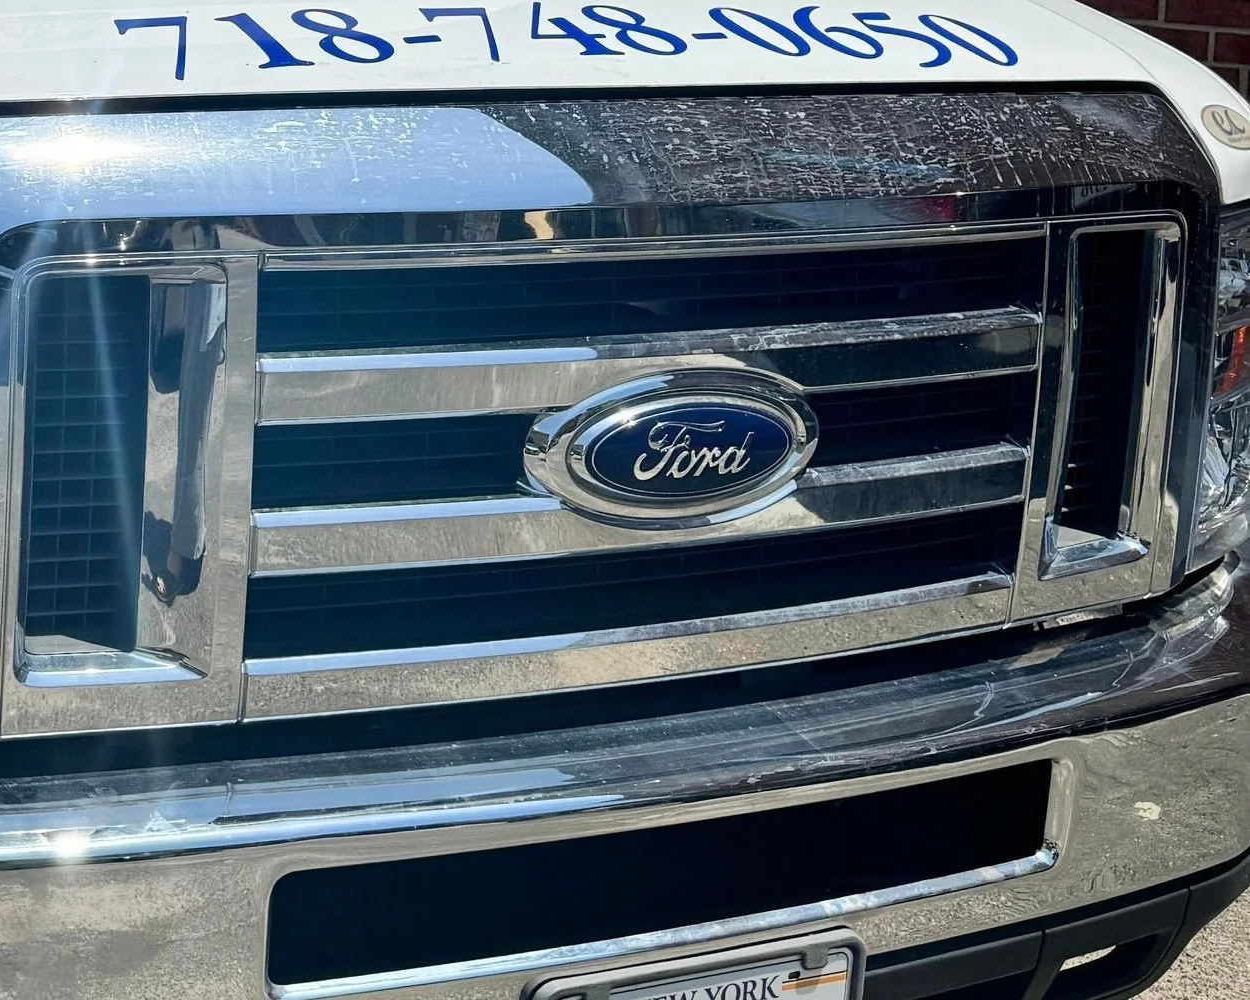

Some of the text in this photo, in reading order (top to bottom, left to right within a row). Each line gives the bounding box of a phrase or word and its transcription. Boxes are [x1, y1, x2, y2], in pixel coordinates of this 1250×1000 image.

[113, 1, 1019, 81] 718-748-0650
[632, 419, 755, 482] Ford
[704, 975, 780, 1000] YORK
